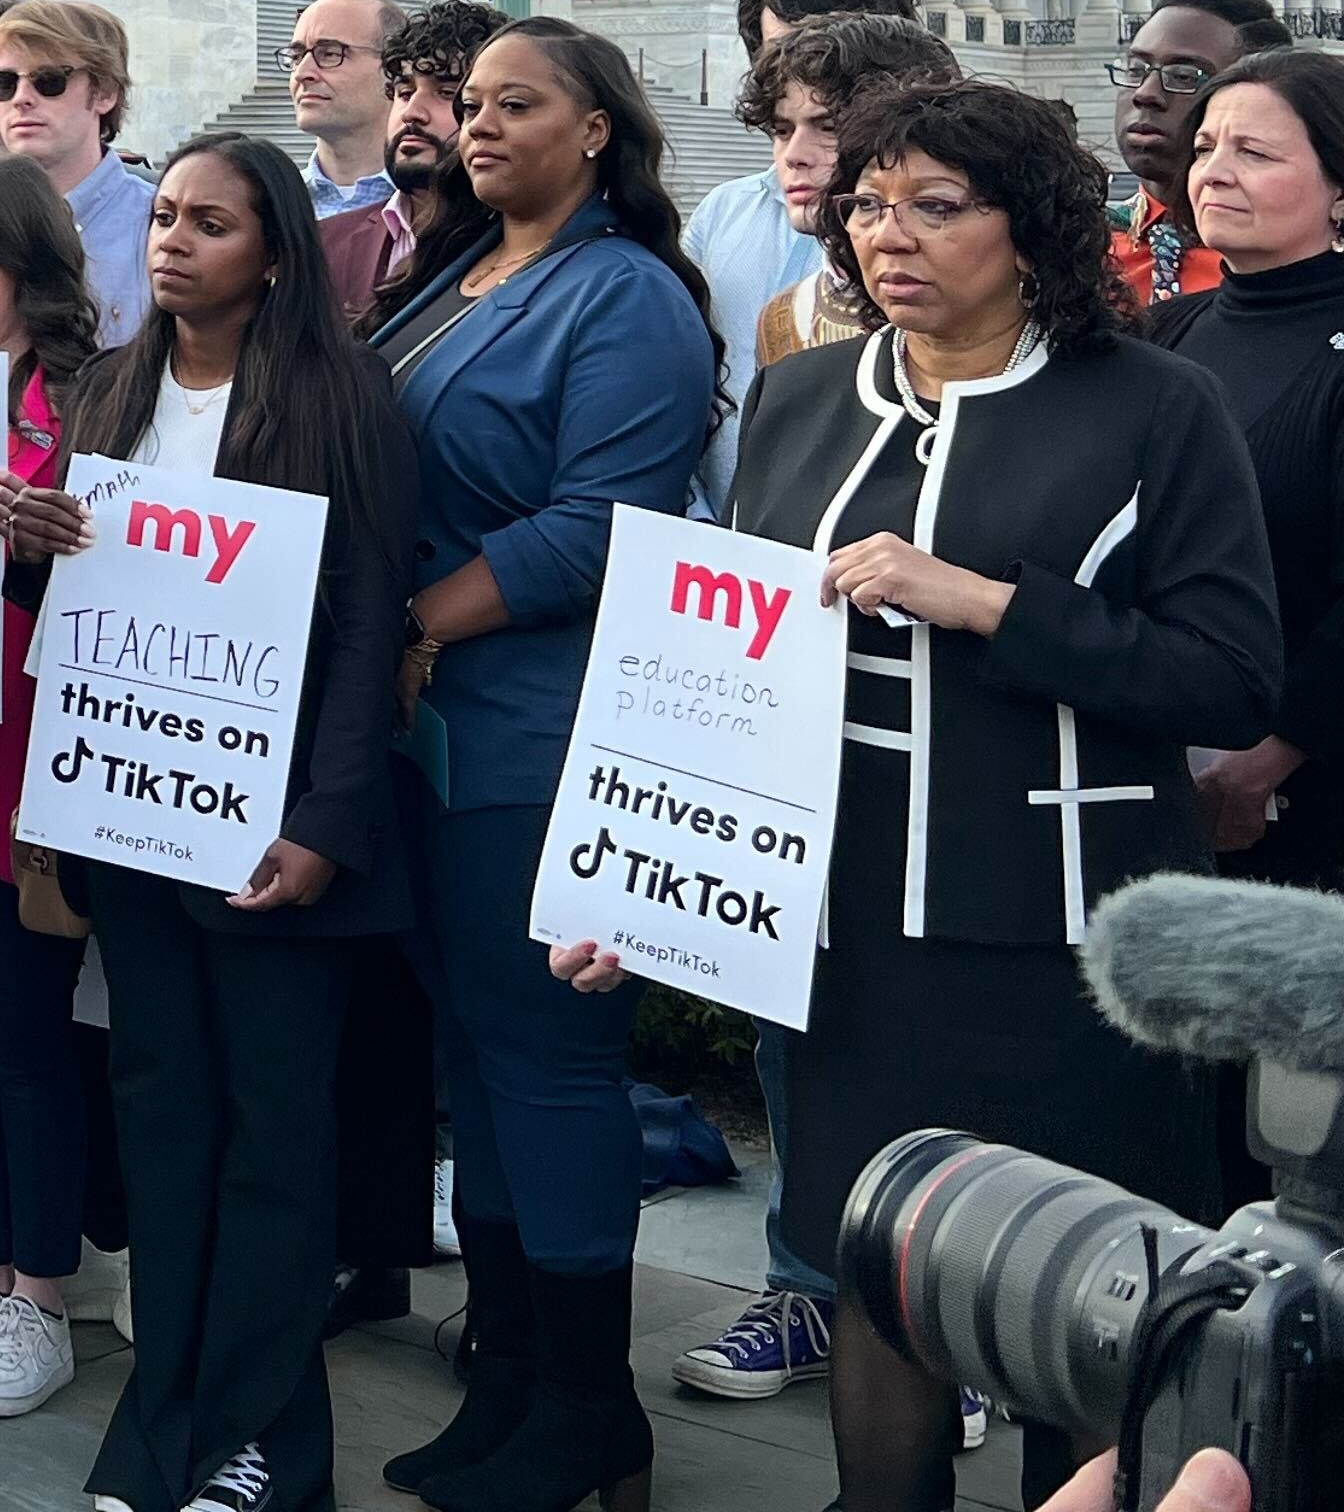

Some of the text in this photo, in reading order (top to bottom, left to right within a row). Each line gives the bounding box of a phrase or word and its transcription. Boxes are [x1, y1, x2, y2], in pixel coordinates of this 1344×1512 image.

[126, 499, 256, 585] my
[669, 560, 792, 661] my
[61, 608, 280, 699] TEACHING
[619, 654, 779, 708] education
[60, 682, 270, 759] thrives on
[616, 686, 758, 737] platform
[100, 754, 250, 825] TikTok
[588, 765, 807, 864] thrives on
[93, 825, 194, 862] #KeepTikTok
[624, 850, 783, 941] TikTok
[612, 930, 721, 978] #KeepTikTok
